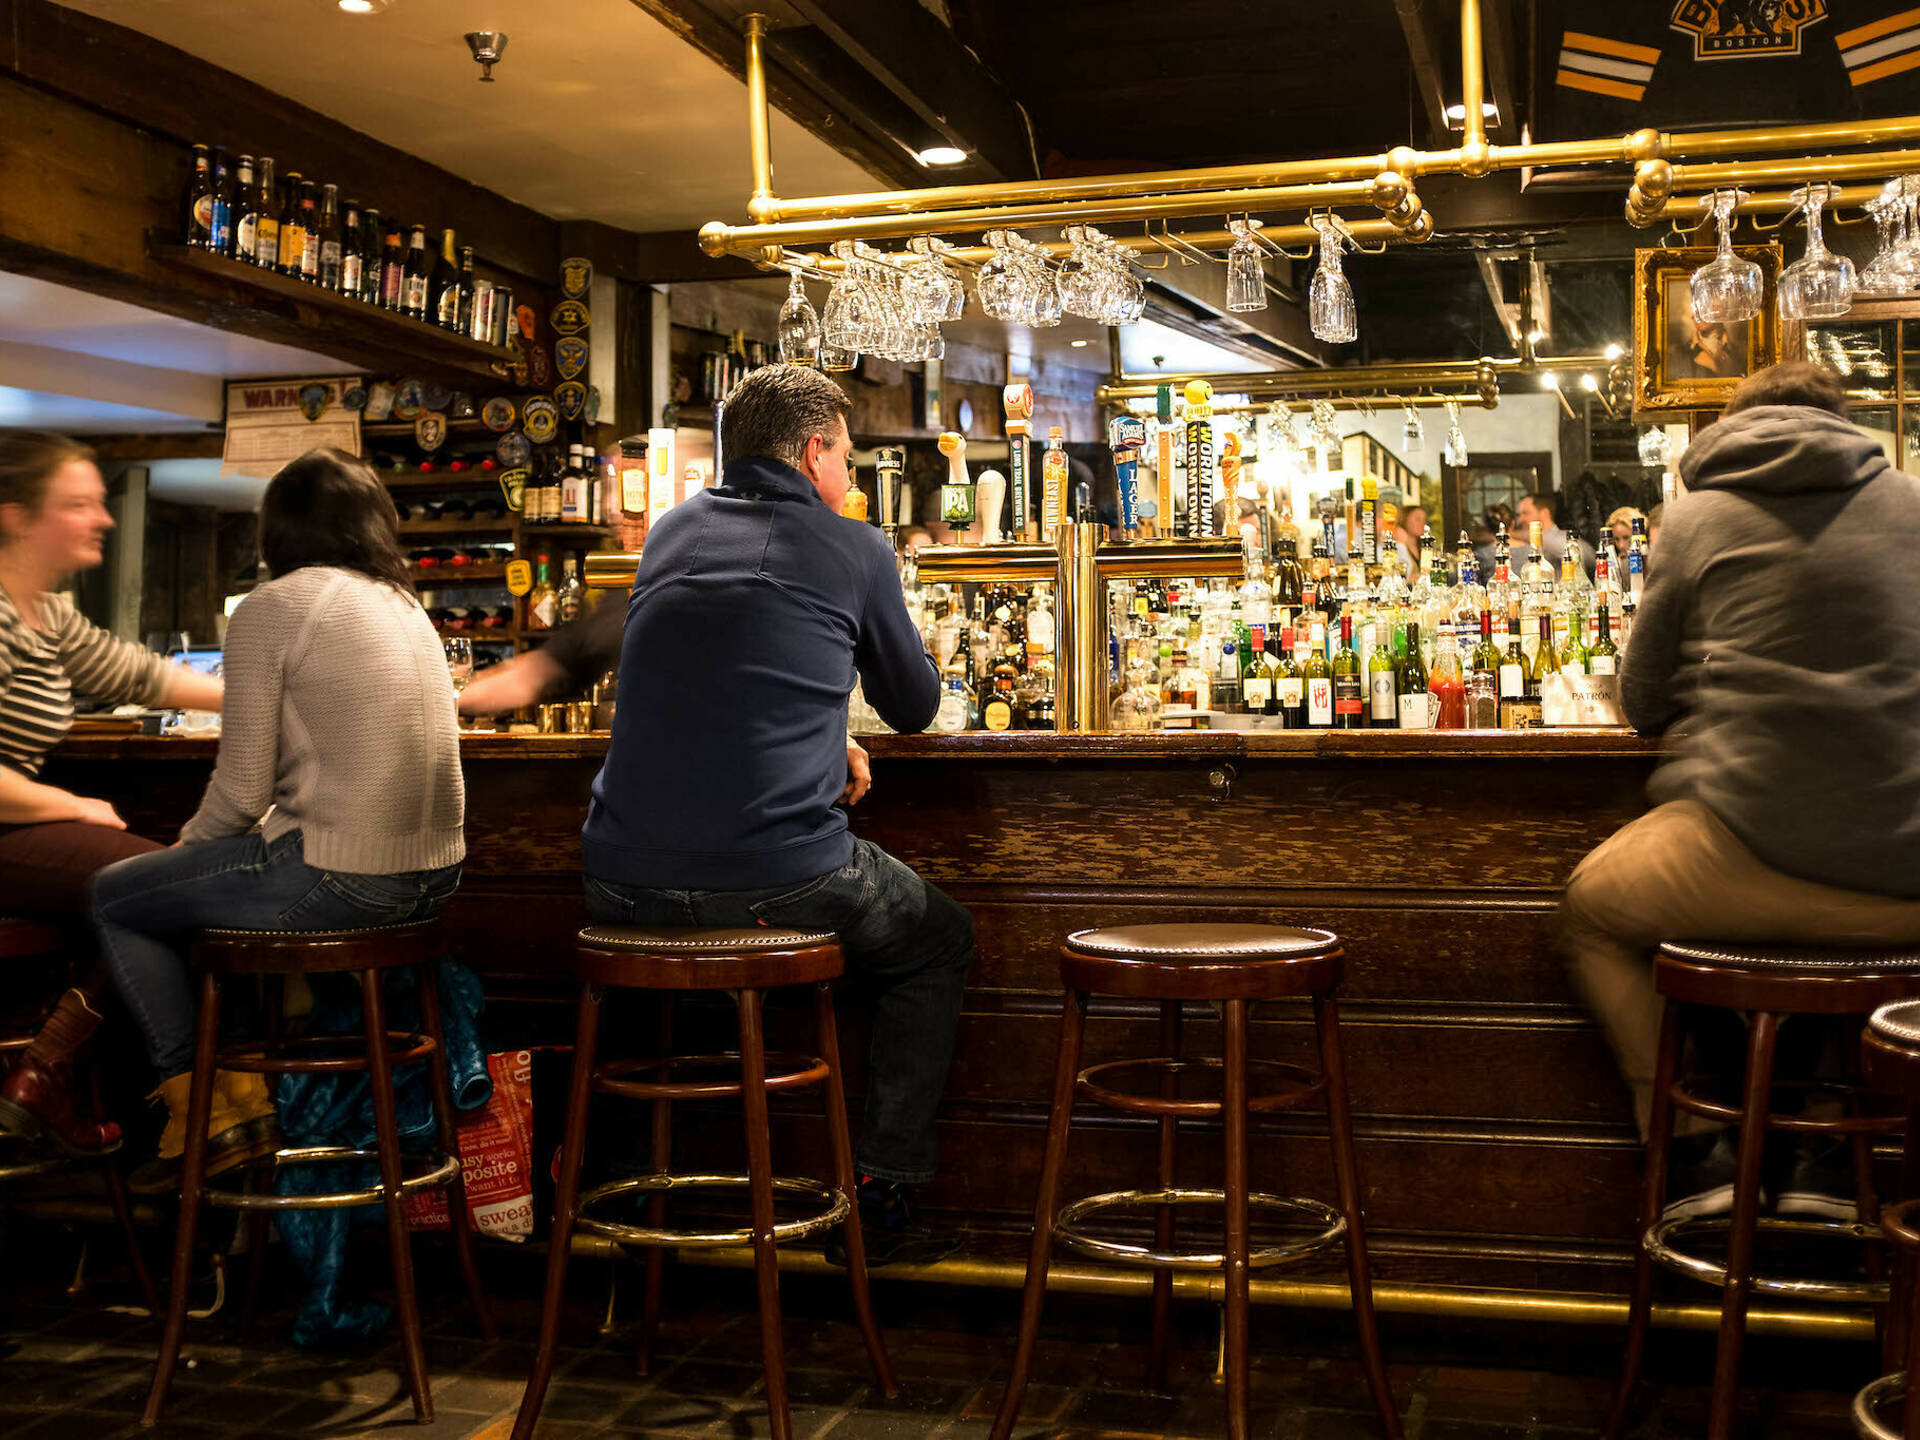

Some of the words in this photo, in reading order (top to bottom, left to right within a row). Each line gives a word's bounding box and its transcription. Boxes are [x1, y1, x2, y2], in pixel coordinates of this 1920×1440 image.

[1713, 36, 1782, 48] BOSTON
[1014, 467, 1022, 486] TRAIL
[1188, 424, 1199, 537] WORMTOWN
[1200, 425, 1213, 537] WORMTOWN
[944, 493, 969, 512] IPA
[1128, 469, 1138, 525] LAGER
[463, 1160, 518, 1186] posite
[480, 1205, 531, 1227] swea
